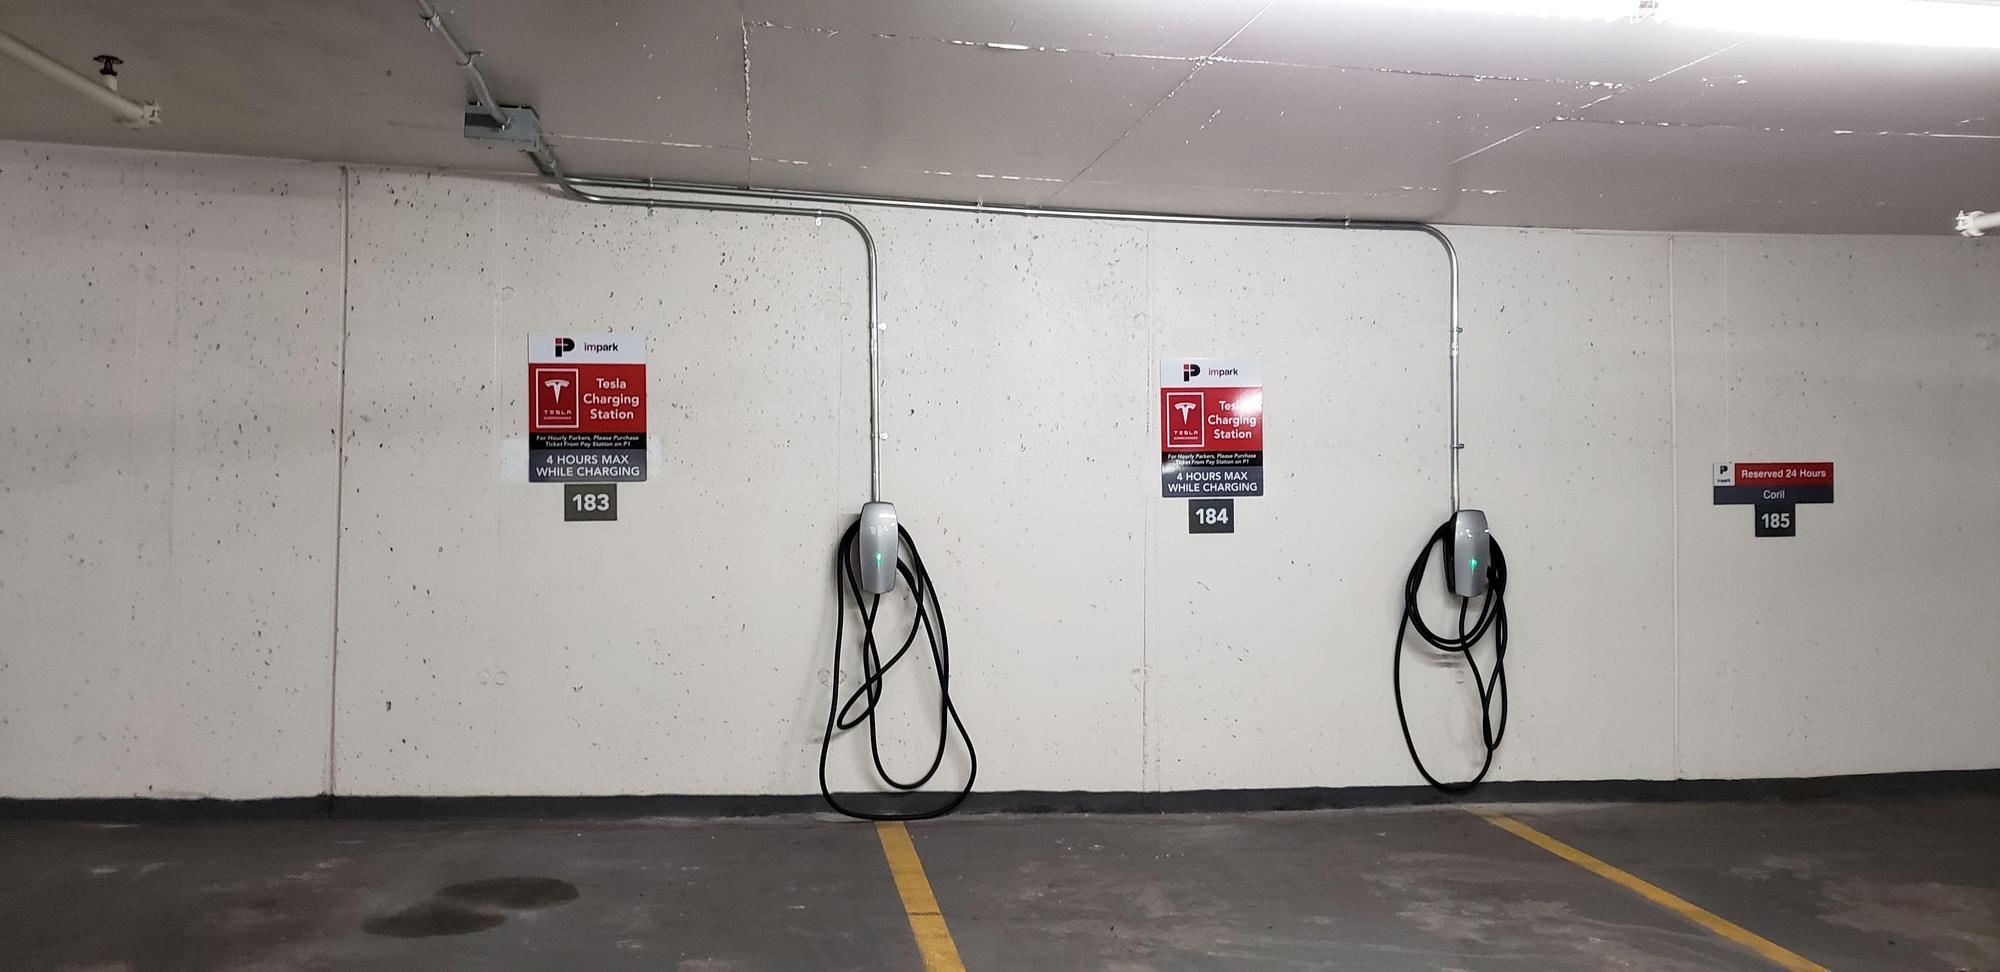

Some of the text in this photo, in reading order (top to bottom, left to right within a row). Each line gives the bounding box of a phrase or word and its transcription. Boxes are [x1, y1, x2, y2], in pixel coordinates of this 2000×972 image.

[584, 342, 618, 353] impark
[1208, 368, 1238, 378] impark
[596, 378, 626, 389] Tesla
[583, 393, 639, 406] Charging
[590, 409, 634, 420] Station
[1208, 415, 1257, 427] Charging
[1213, 430, 1252, 439] Station
[546, 455, 629, 464] 4 HOURS MAX
[536, 467, 640, 476] WHILE CHARGING
[1176, 472, 1248, 481] 4 HOURS MAX
[1741, 469, 1826, 479] Reserved 24 Hours
[1168, 482, 1257, 492] WHILE CHARGING
[1763, 489, 1785, 499] Coril
[572, 494, 609, 511] 183
[1195, 508, 1228, 525] 184
[1761, 513, 1790, 529] 185
